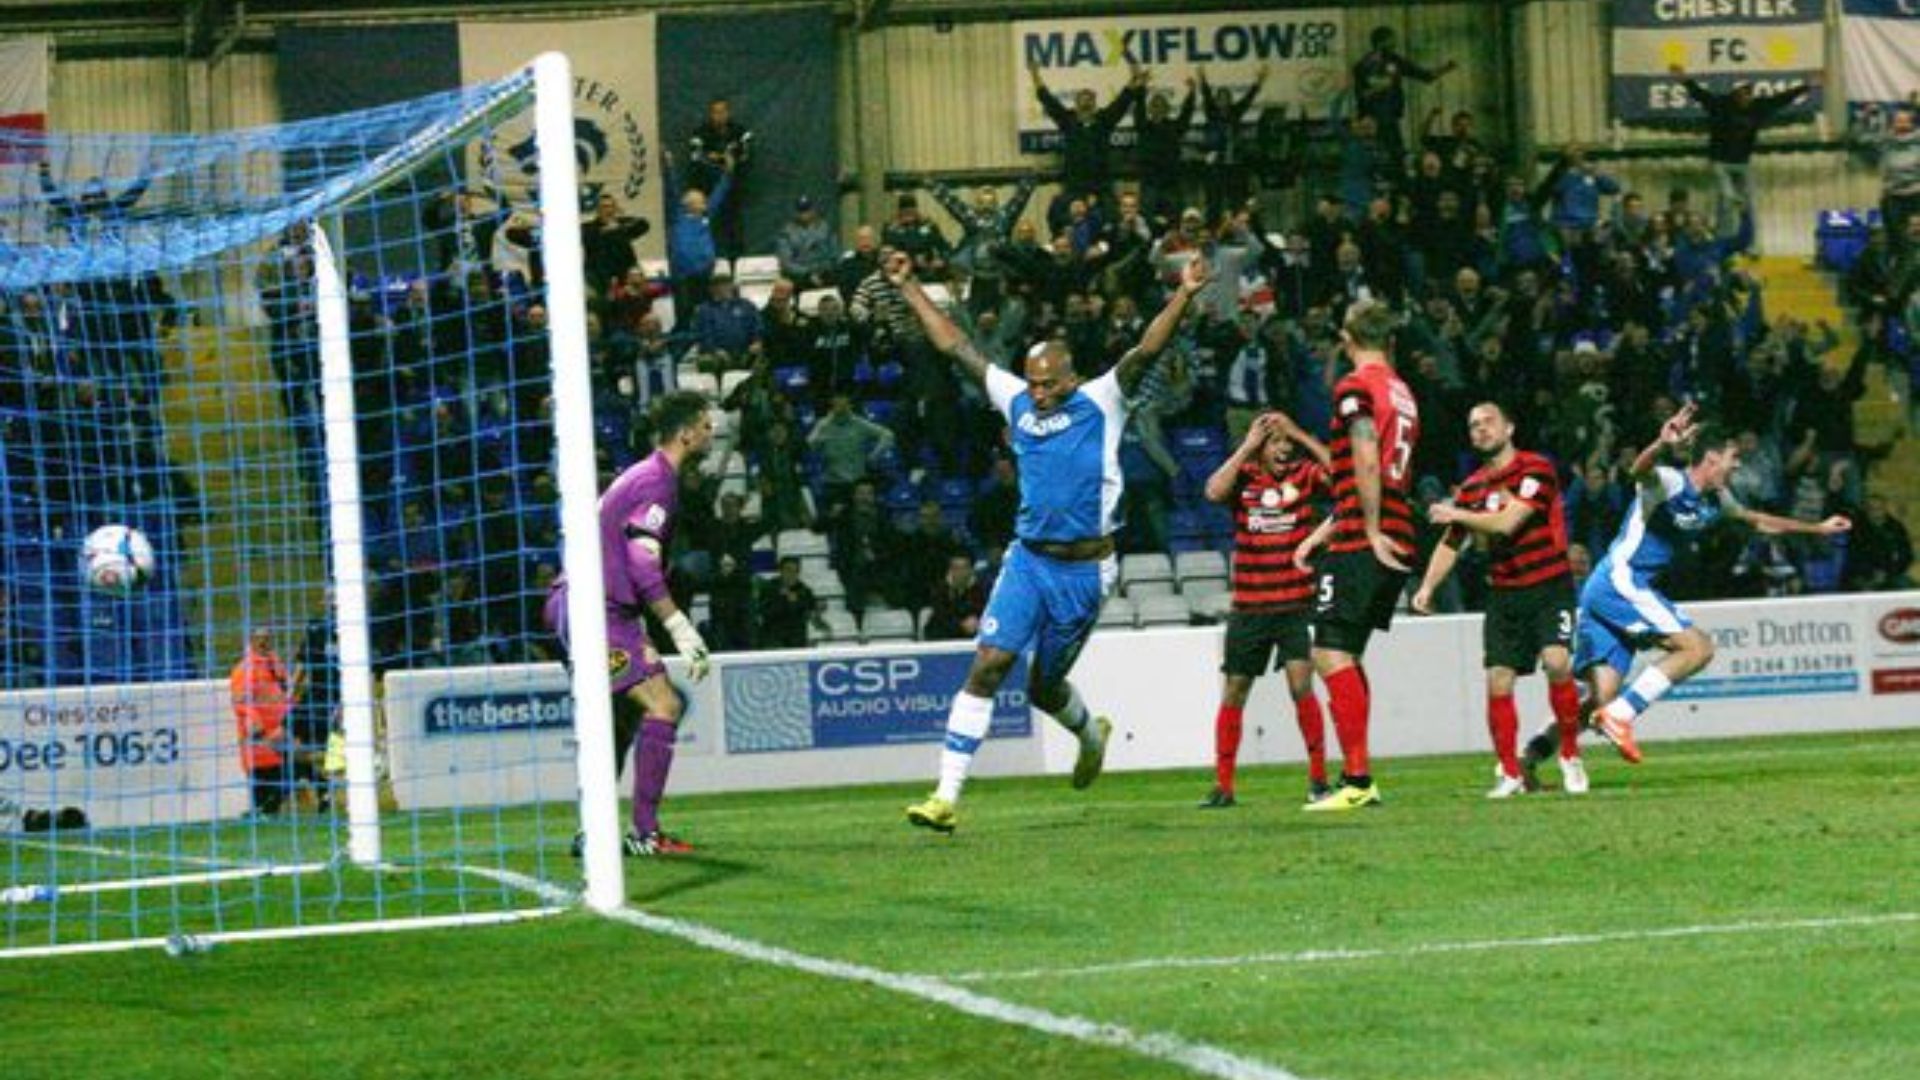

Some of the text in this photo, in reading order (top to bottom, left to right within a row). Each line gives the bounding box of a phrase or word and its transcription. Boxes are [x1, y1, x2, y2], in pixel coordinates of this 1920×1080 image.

[1655, 0, 1797, 21] CHESTER
[1025, 23, 1297, 68] MAXIFLOW
[1708, 38, 1747, 63] FC
[1392, 415, 1411, 480] 5
[1318, 574, 1334, 602] 5
[1558, 609, 1571, 633] 3
[1757, 618, 1852, 648] Dutton
[817, 659, 920, 695] CSP
[817, 689, 1026, 717] AUDIO VISU TD
